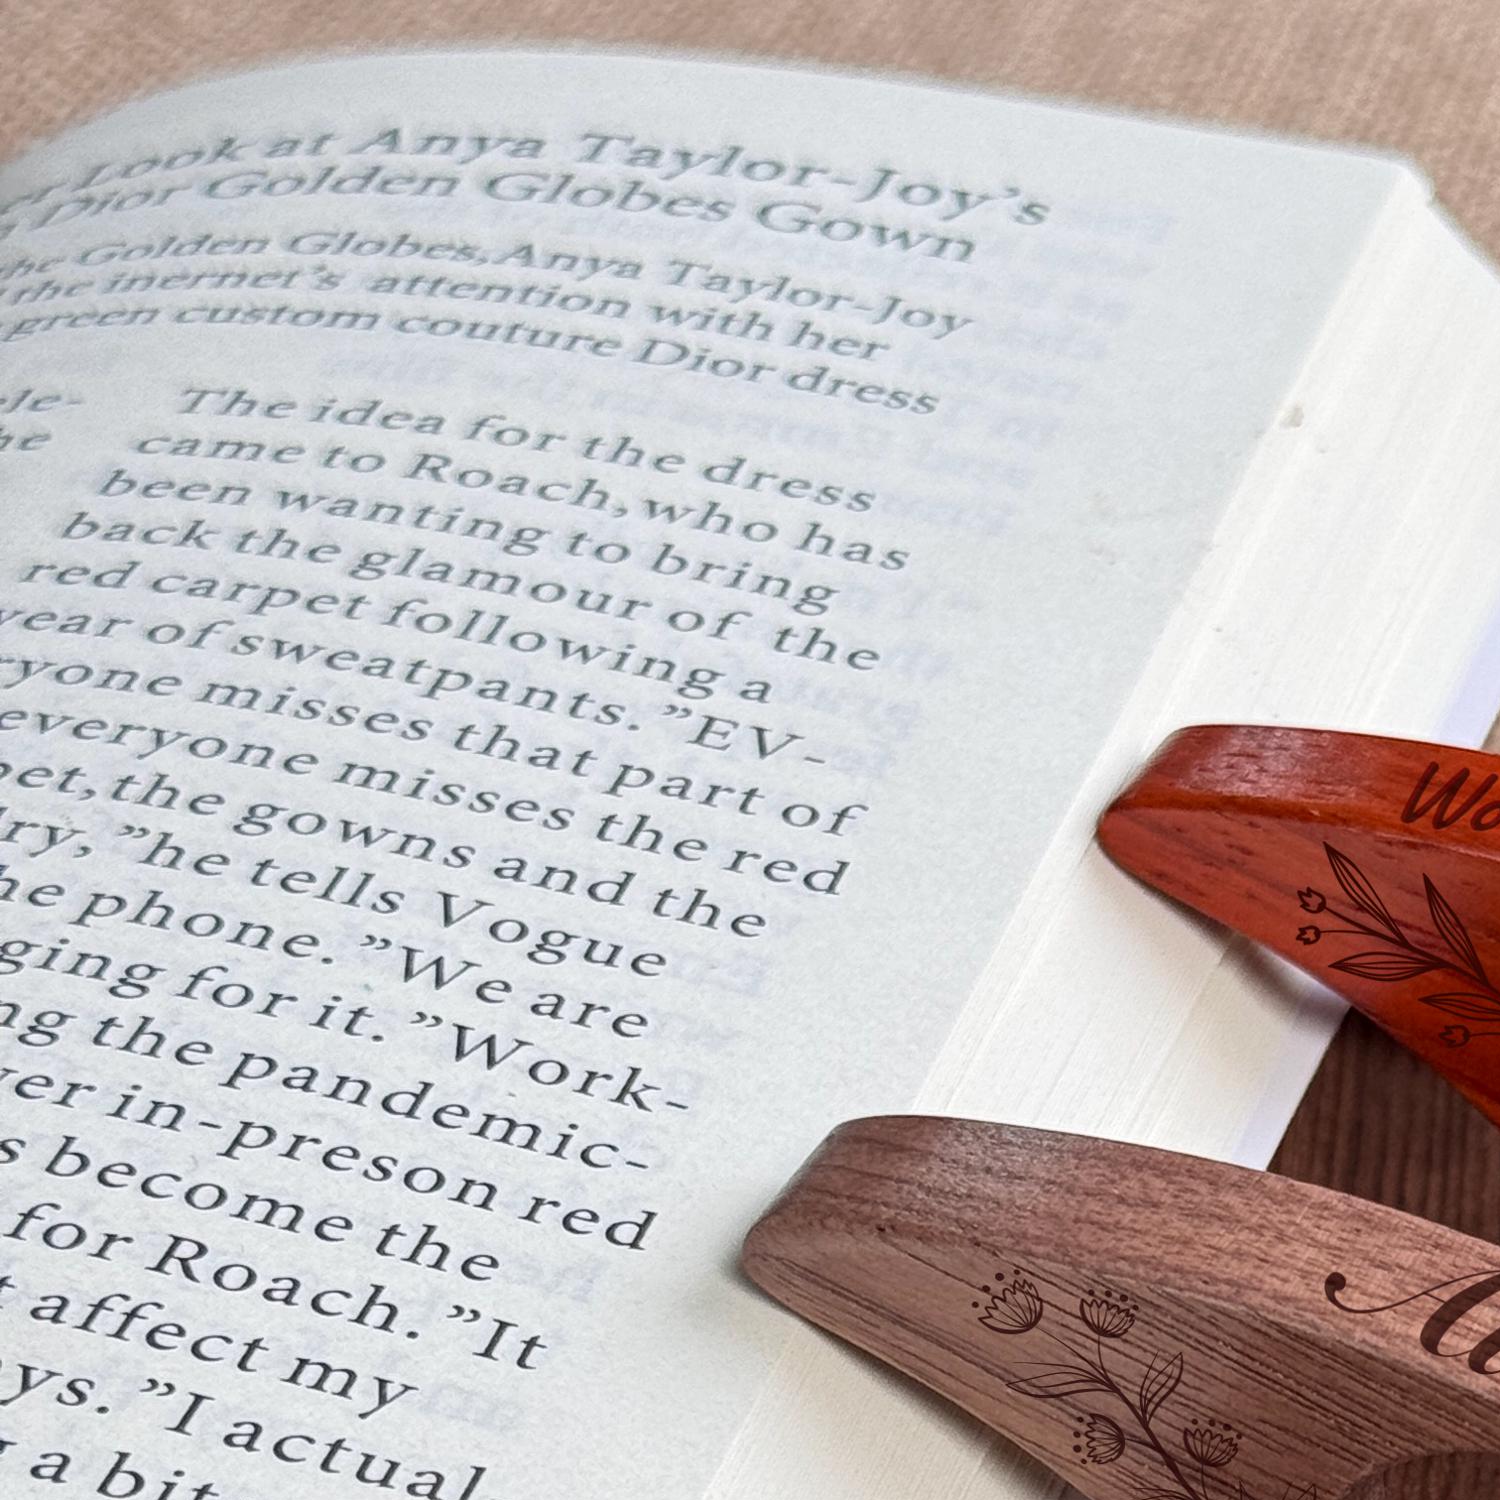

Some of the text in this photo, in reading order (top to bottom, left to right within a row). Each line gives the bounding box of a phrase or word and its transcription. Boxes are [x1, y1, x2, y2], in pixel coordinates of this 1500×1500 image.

[205, 165, 462, 199] Golden
[483, 170, 735, 222] Globes
[756, 200, 976, 264] Gown
[263, 130, 337, 159] at
[348, 127, 547, 165] Anya
[78, 233, 270, 265] Golden
[666, 257, 976, 340] Taylor-Joy
[367, 271, 631, 319] attention
[648, 304, 775, 342] with
[783, 320, 890, 362] her
[2, 304, 941, 415] green custom couture Dior dress
[135, 434, 306, 465] came
[322, 445, 387, 474] to
[794, 521, 910, 571] has
[178, 387, 877, 513] The idea for the dress
[61, 510, 882, 672] back the glamour of the
[97, 468, 840, 617] been wanting to bring
[19, 560, 774, 704] red carpet following a
[146, 619, 236, 649] of
[229, 632, 641, 732] sweatpants.
[0, 656, 870, 838] yone misses that part of
[0, 708, 851, 896] everyone misses the red
[0, 806, 92, 859] ry,
[250, 857, 406, 915] tells
[437, 890, 669, 978] Vogue
[110, 772, 227, 817] the
[231, 801, 478, 870] gowns
[493, 855, 638, 907] and
[651, 886, 768, 939] the
[0, 937, 168, 999] ging
[175, 964, 299, 1017] for
[309, 994, 386, 1043] it.
[69, 889, 335, 966] phone.
[529, 992, 650, 1039] are
[92, 1014, 214, 1067] the
[218, 1050, 651, 1171] pandemic-
[44, 1135, 354, 1242] become
[375, 1223, 501, 1281] the
[105, 1084, 498, 1212] in-preson
[517, 1195, 659, 1251] red
[2, 1202, 135, 1261] for
[145, 1233, 420, 1340] Roach.
[30, 1292, 270, 1373] affect
[281, 1356, 419, 1419] my
[30, 1451, 73, 1484] a
